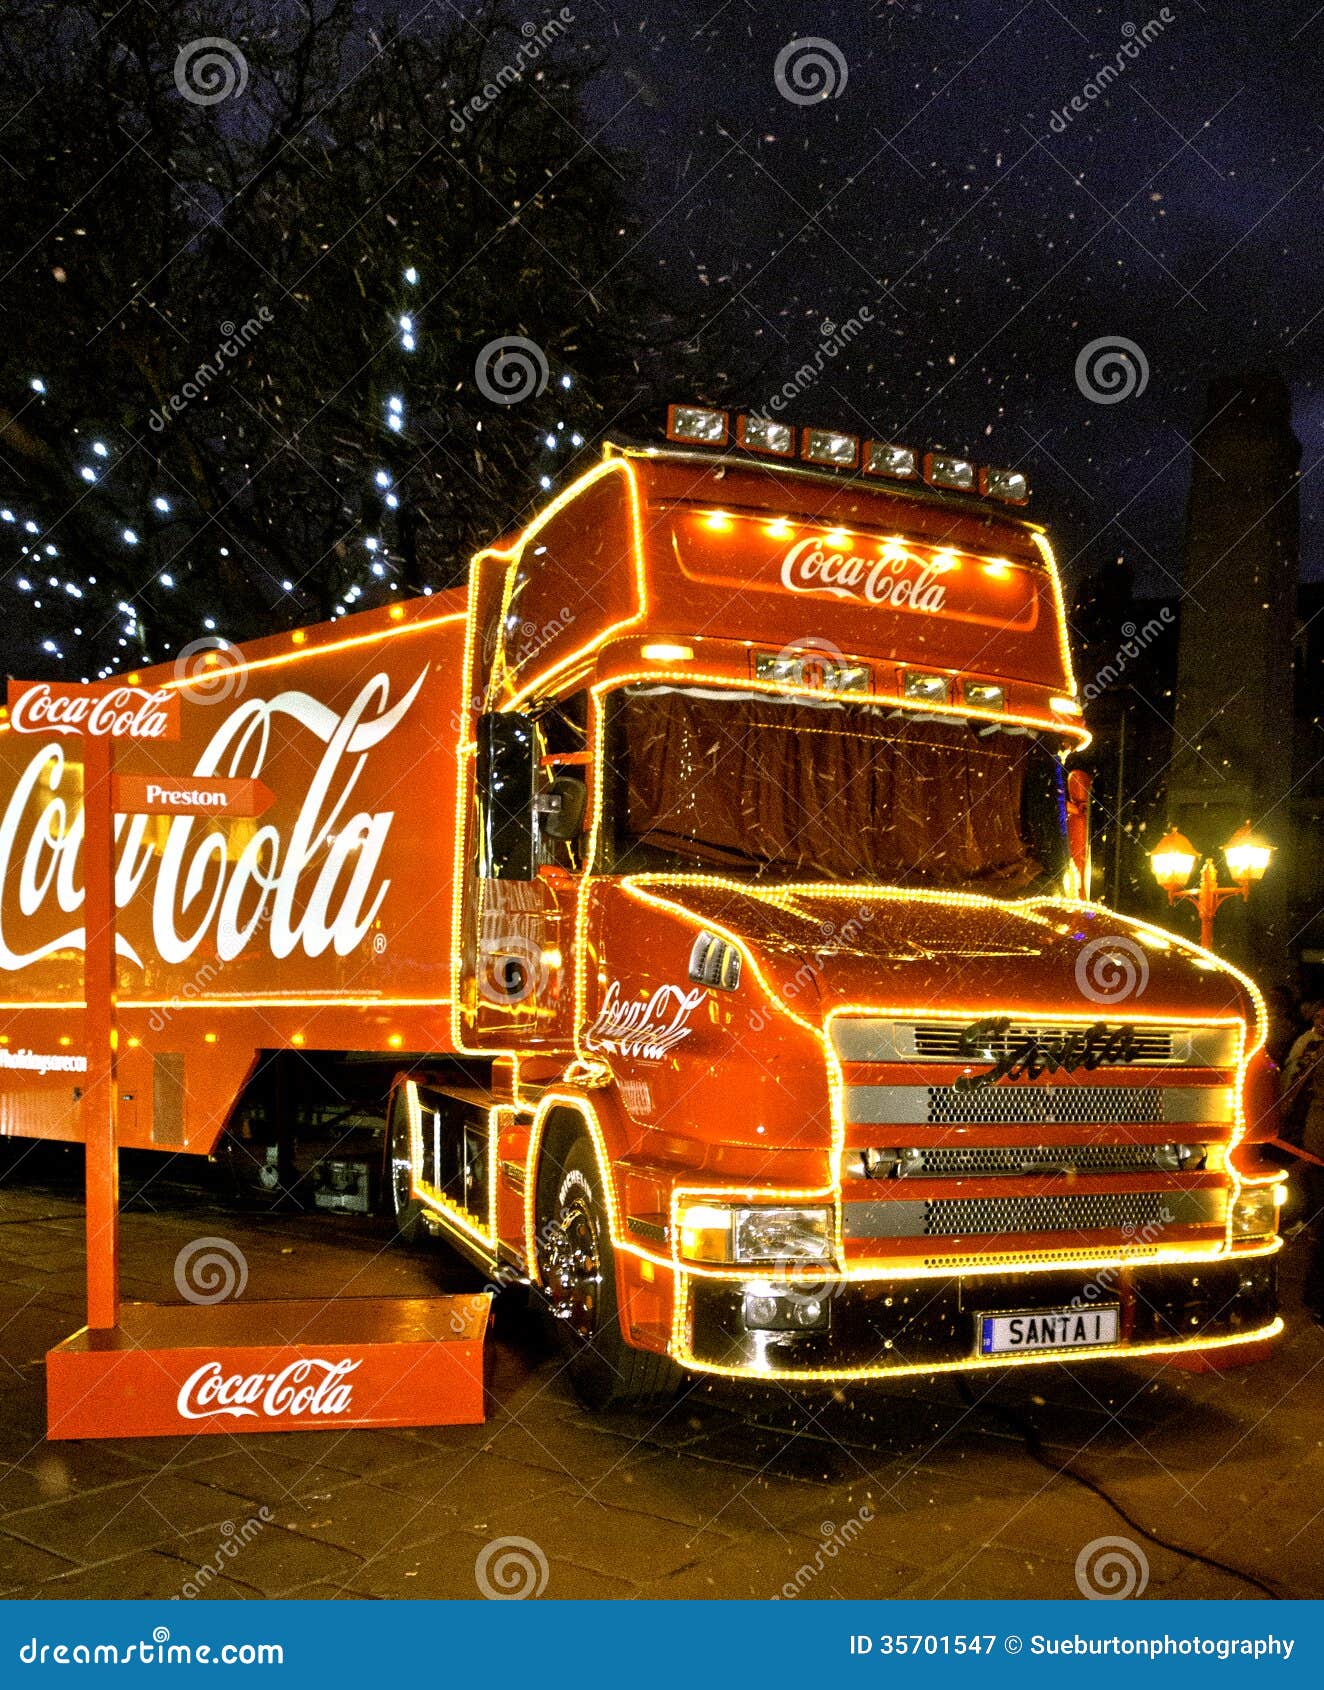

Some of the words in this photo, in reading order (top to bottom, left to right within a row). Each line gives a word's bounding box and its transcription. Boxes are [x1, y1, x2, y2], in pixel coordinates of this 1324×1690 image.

[781, 537, 948, 612] Coca-Cola
[11, 684, 177, 738] Coca-Cola
[0, 660, 430, 970] CocaCola
[146, 785, 228, 806] Preston
[952, 1016, 1144, 1093] Santa
[1010, 1316, 1086, 1344] SANTA
[177, 1358, 364, 1419] Coca-Cola
